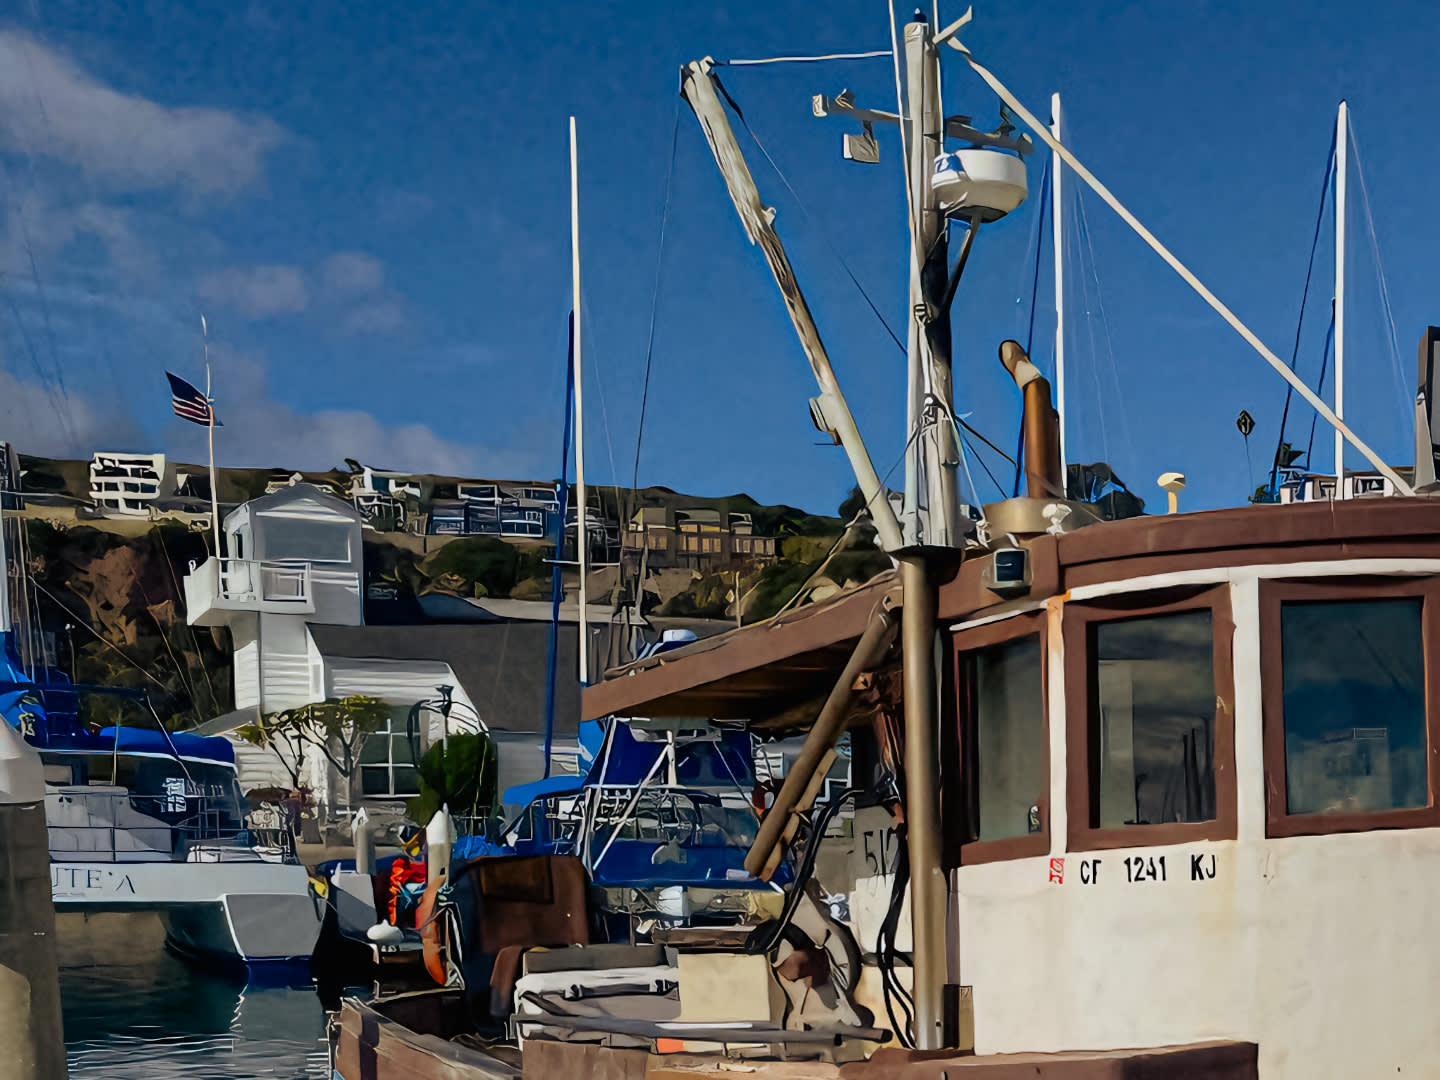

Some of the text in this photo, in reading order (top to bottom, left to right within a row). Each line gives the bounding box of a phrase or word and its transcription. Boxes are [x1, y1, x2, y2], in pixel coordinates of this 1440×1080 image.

[1080, 859, 1102, 884] CF
[1123, 856, 1167, 883] 1241
[1191, 854, 1216, 881] KJ
